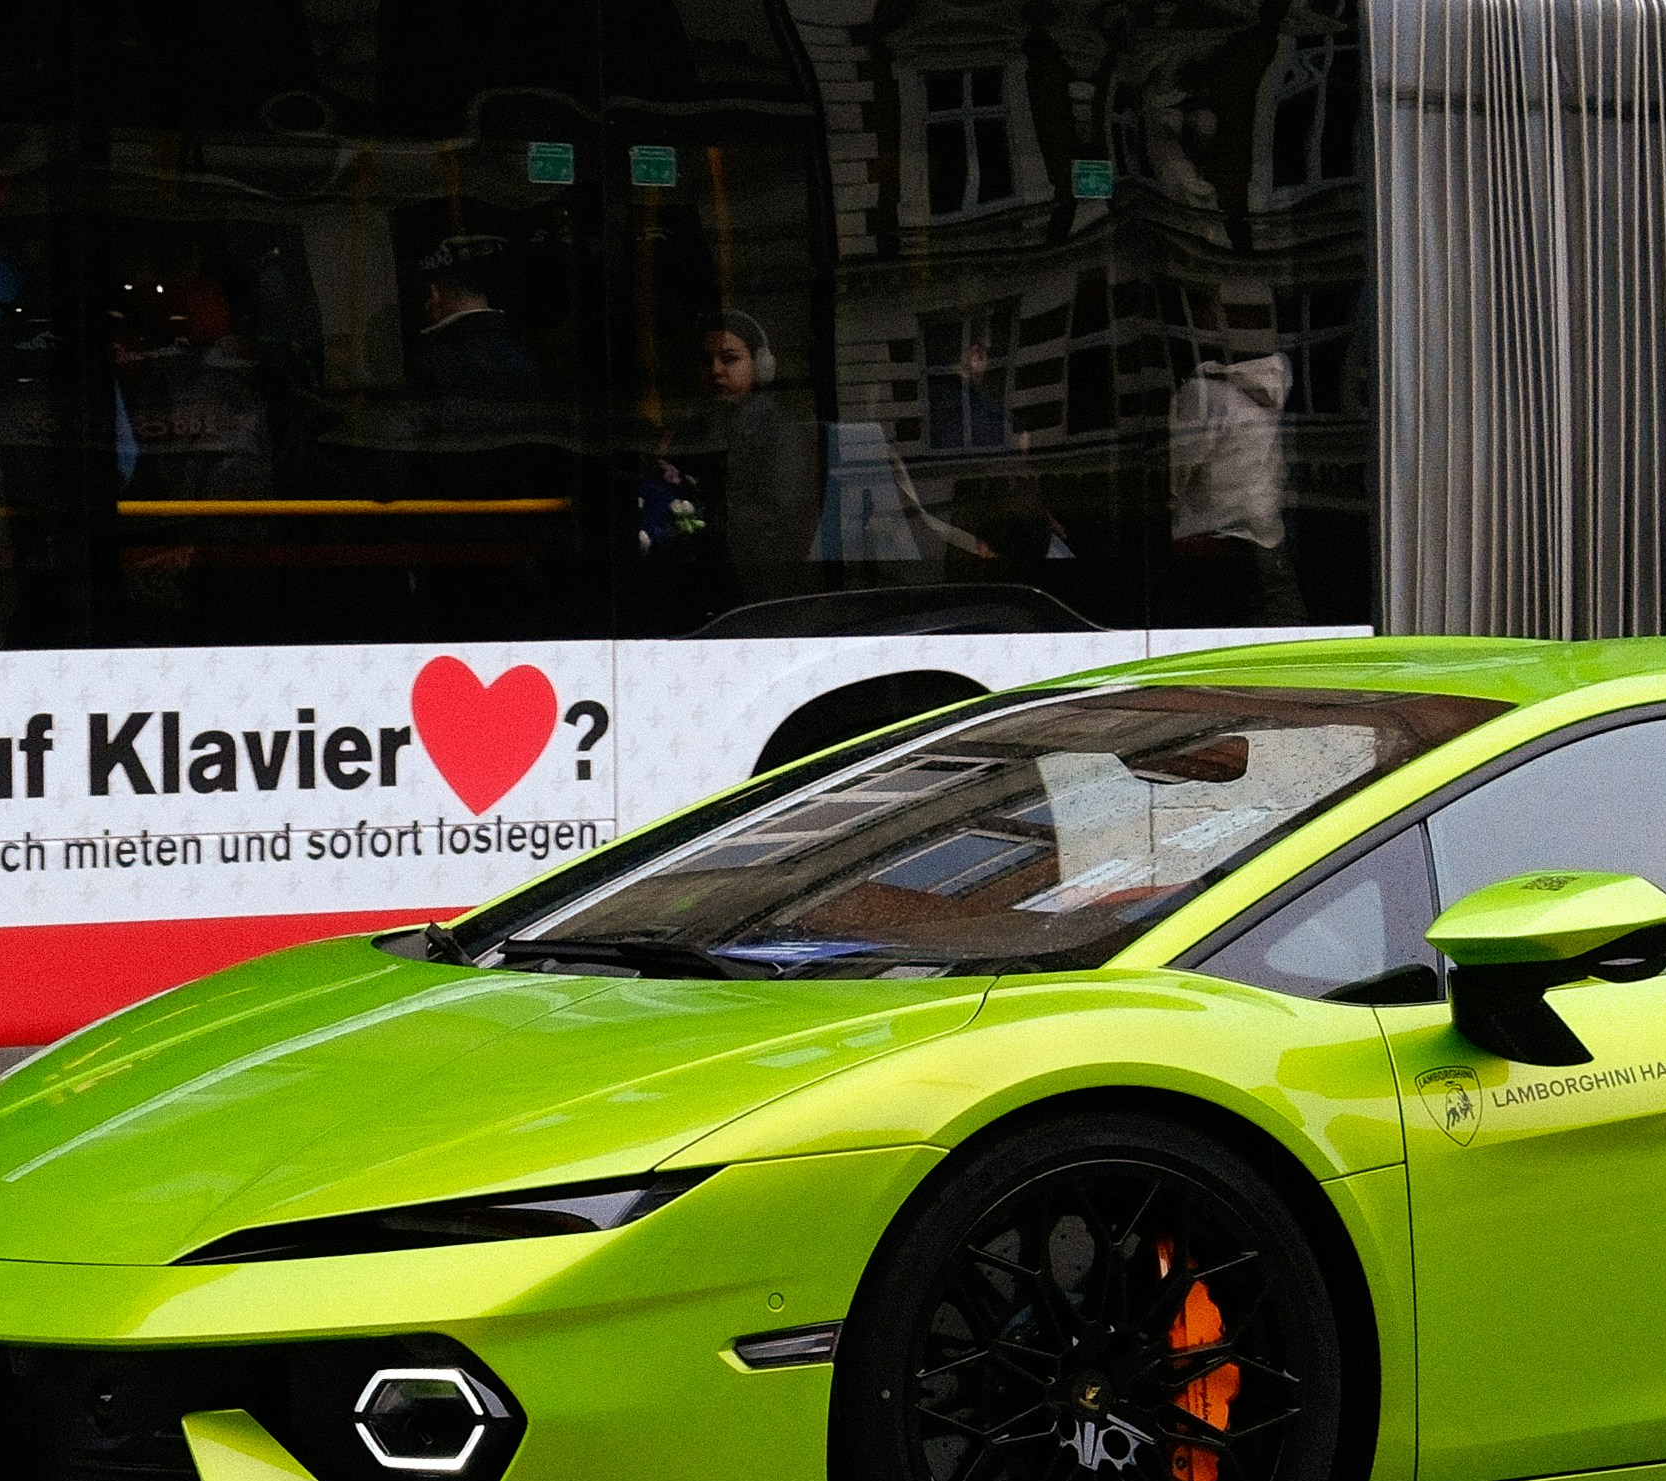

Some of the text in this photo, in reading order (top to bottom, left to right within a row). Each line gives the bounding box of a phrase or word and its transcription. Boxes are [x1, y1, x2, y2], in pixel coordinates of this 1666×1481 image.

[88, 707, 413, 797] Klavier
[561, 699, 610, 782] ?
[61, 829, 202, 871] mieten
[219, 825, 294, 865] und
[305, 820, 424, 861] sofort
[435, 815, 610, 862] loslegen.
[1416, 1068, 1476, 1088] LAMBORGHINI
[1490, 1065, 1638, 1109] LAMBORGHINI
